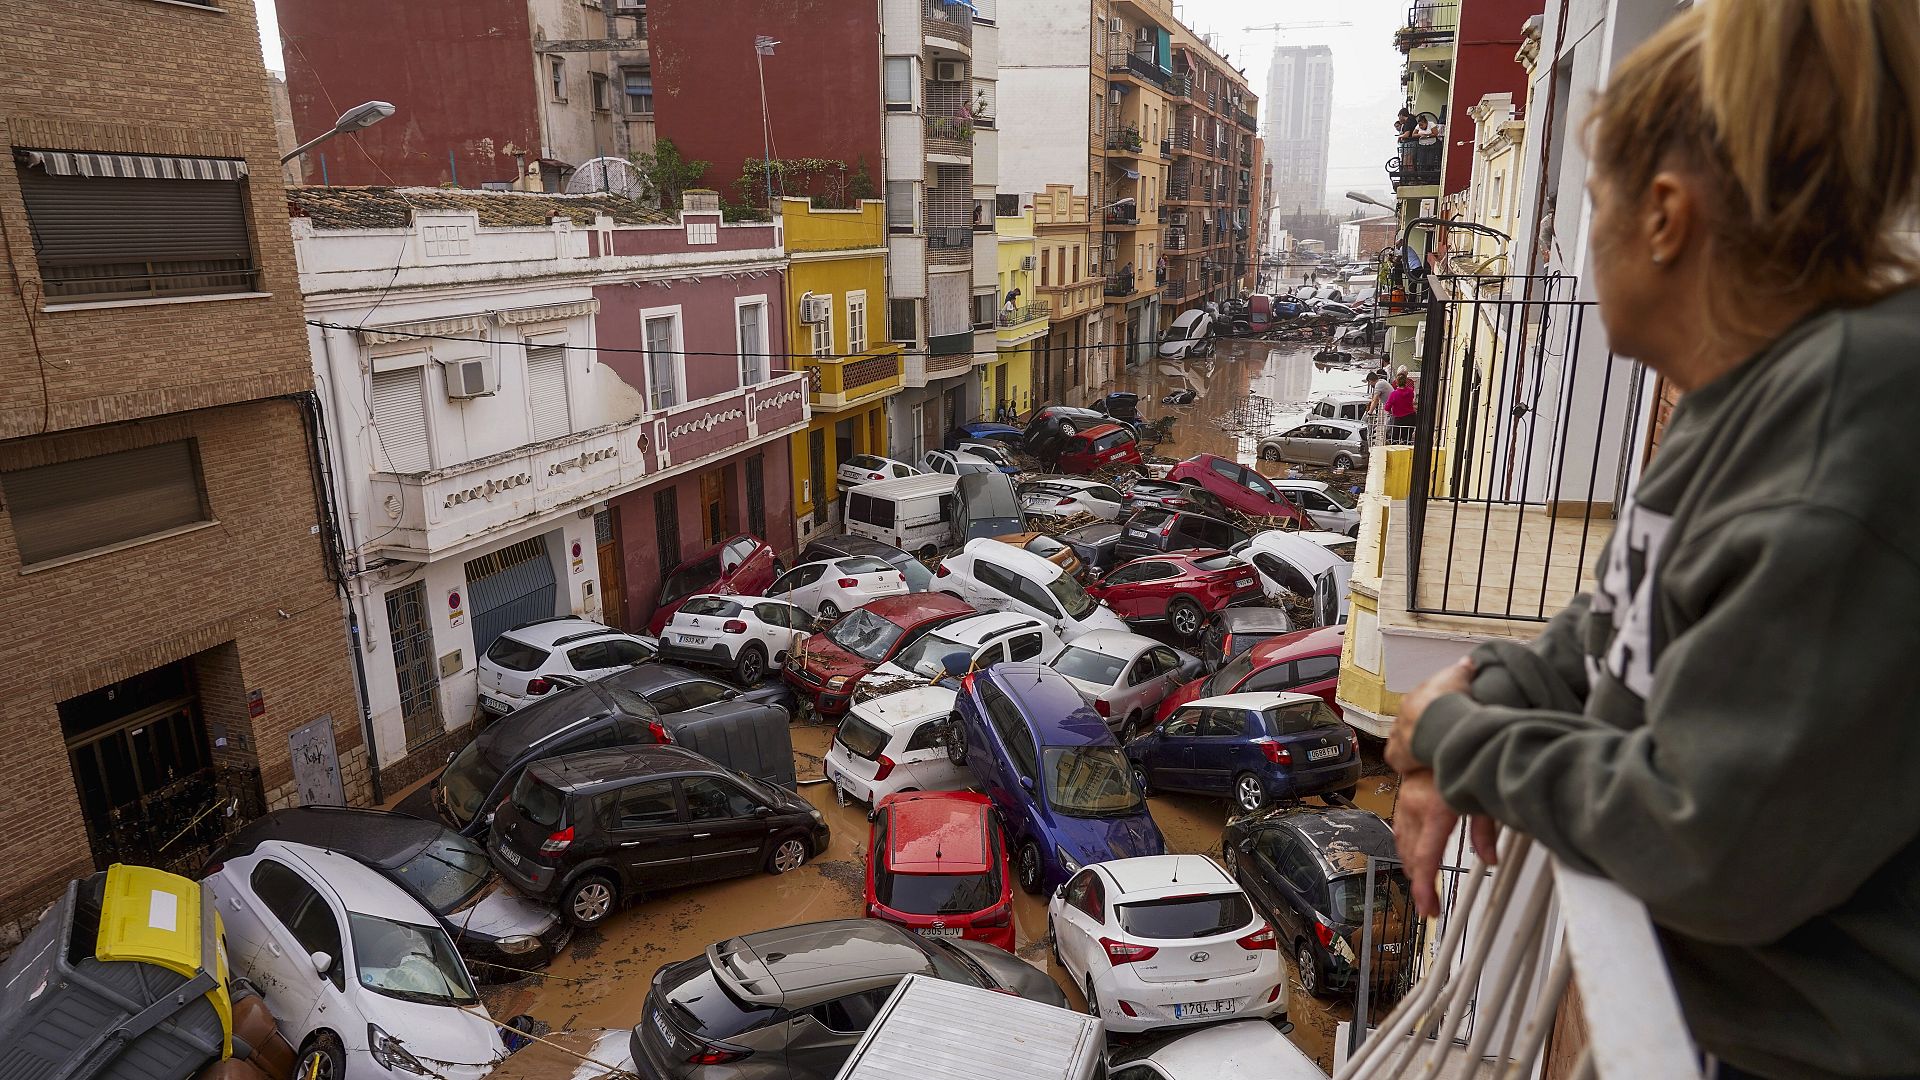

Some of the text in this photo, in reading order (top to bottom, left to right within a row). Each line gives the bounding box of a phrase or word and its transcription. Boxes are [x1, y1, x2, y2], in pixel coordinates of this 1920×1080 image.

[921, 927, 961, 936] 2305 LJV
[1184, 999, 1233, 1015] 1704 JFJ
